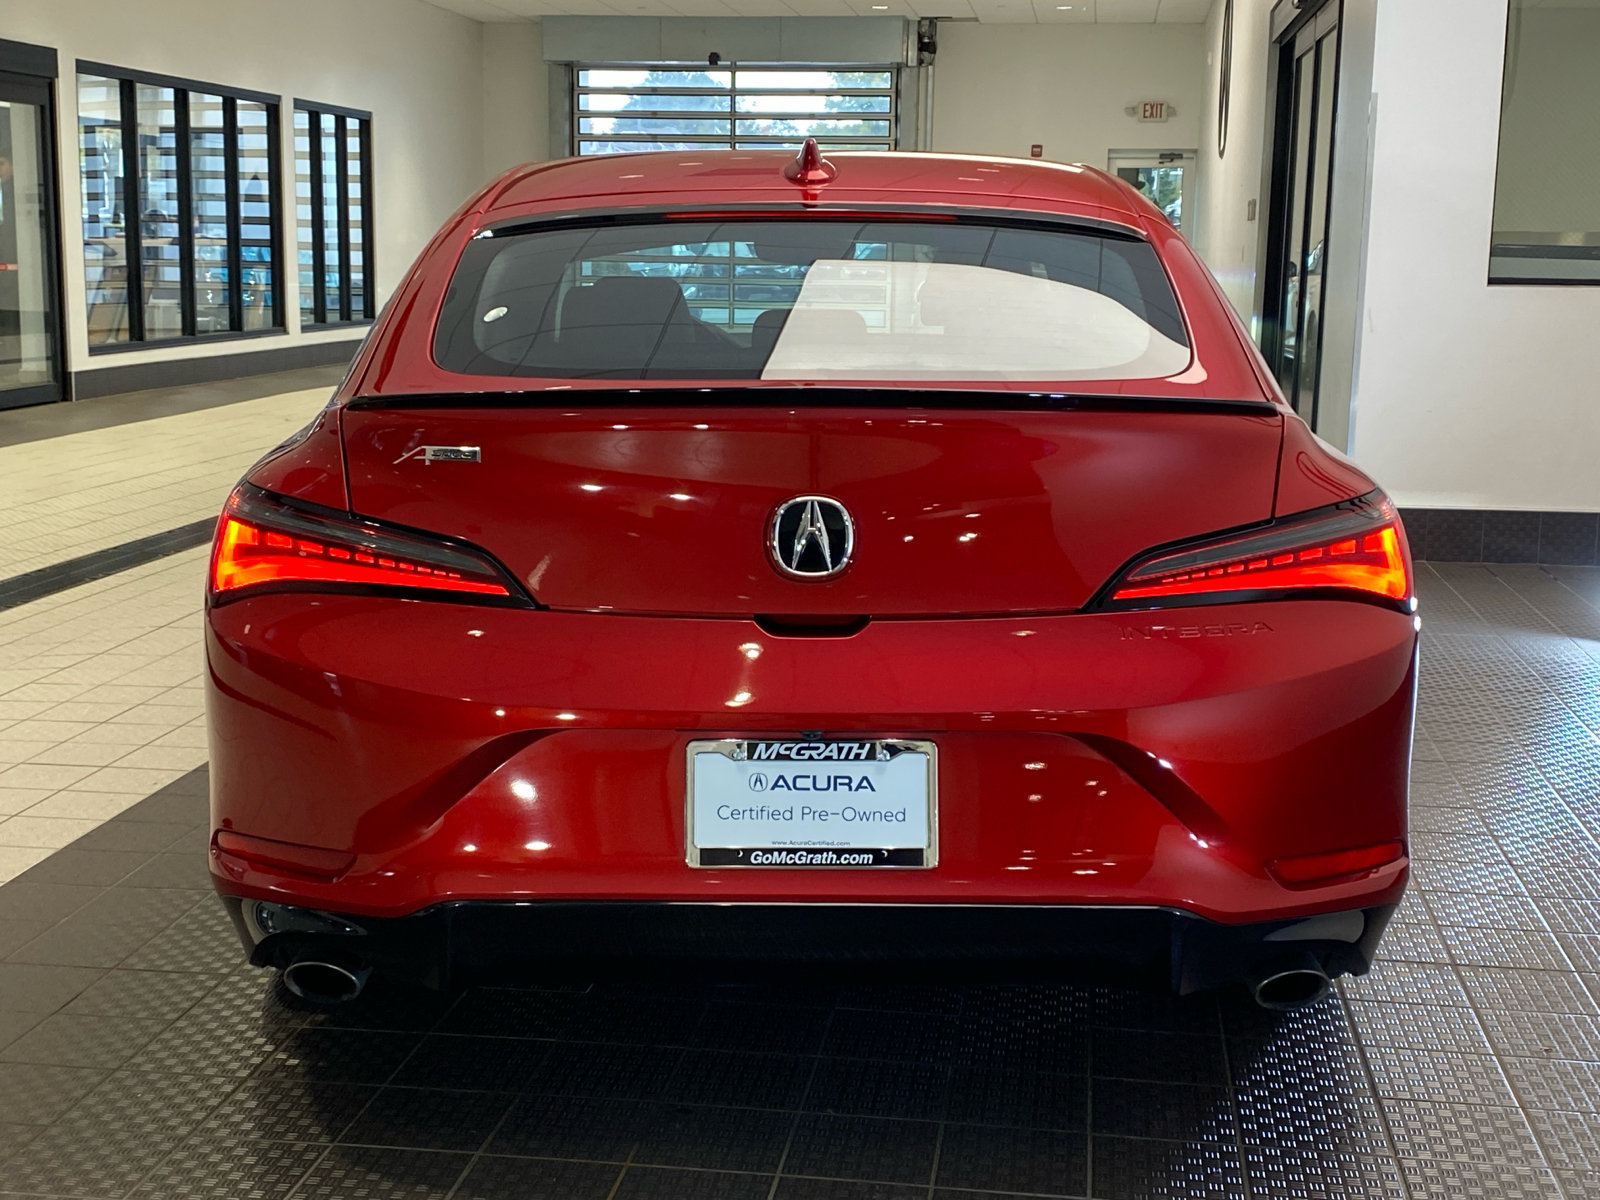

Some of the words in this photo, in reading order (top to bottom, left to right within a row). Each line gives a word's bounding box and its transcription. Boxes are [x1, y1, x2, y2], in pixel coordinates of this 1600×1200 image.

[1143, 102, 1164, 119] EXIT
[1118, 622, 1274, 640] INTEGRA
[770, 774, 876, 792] ACURA
[716, 804, 794, 821] Certified
[801, 806, 907, 822] Pre-Owned
[750, 851, 873, 865] GoMcGrath.com
